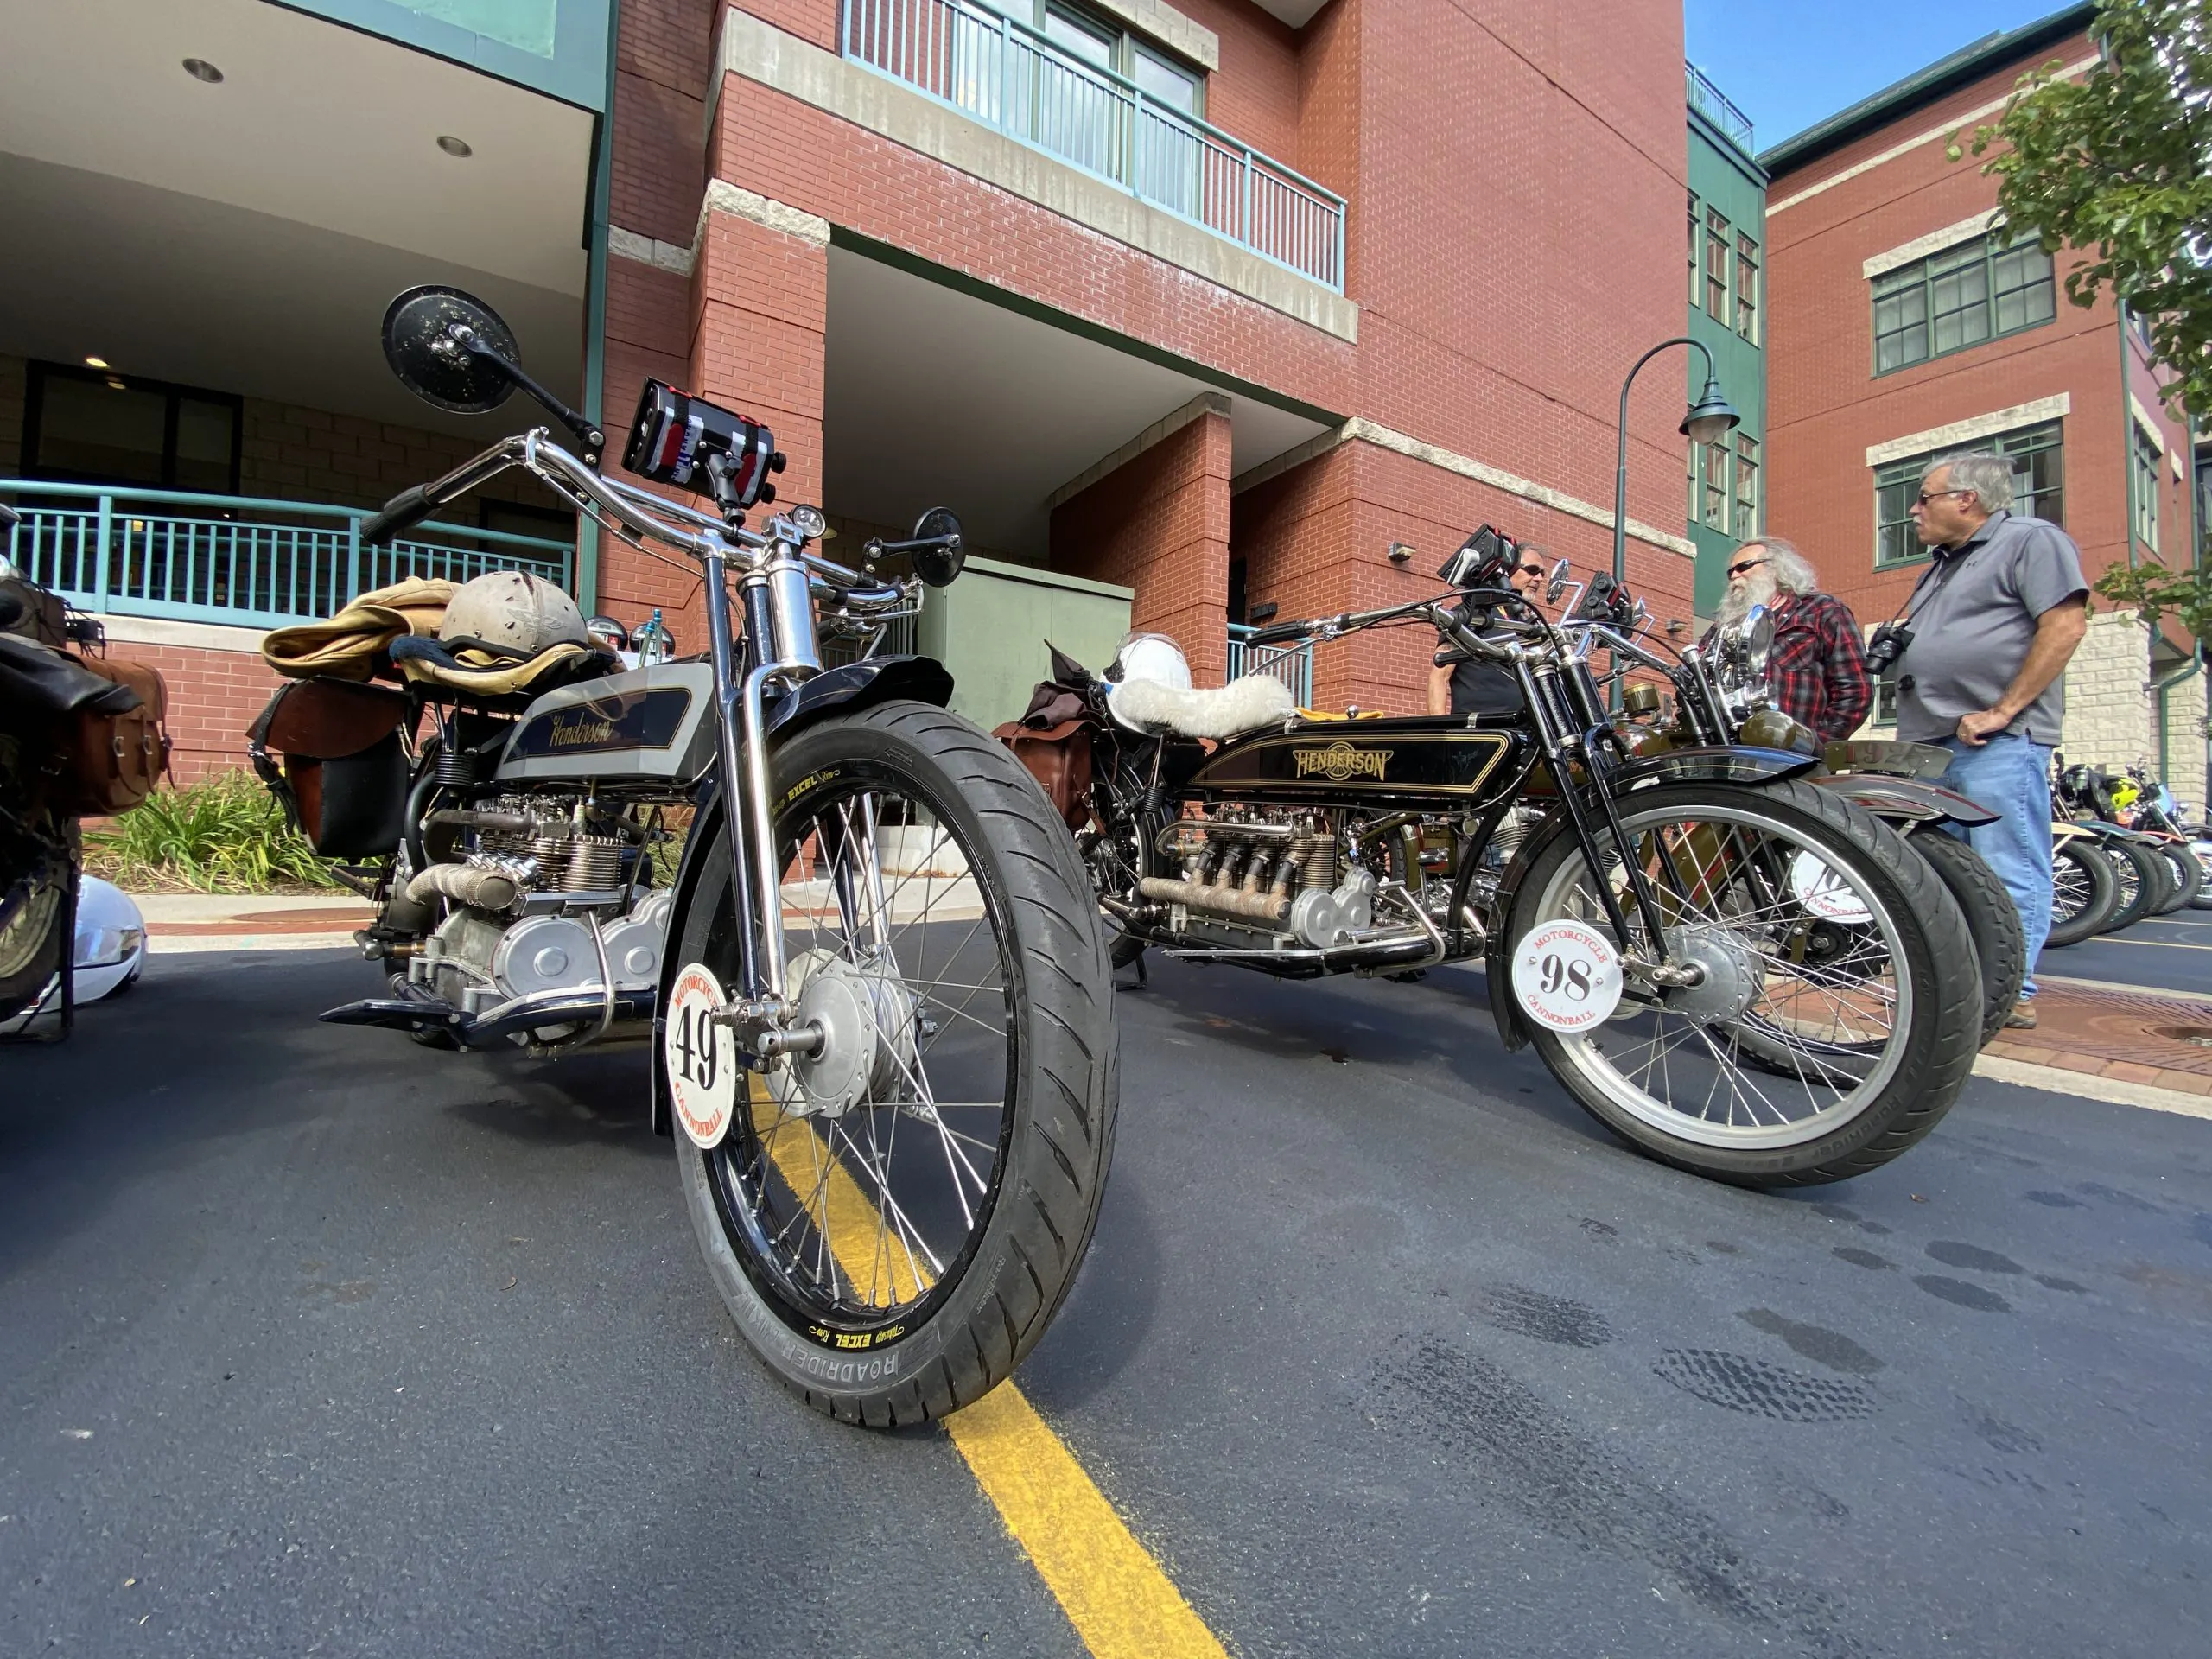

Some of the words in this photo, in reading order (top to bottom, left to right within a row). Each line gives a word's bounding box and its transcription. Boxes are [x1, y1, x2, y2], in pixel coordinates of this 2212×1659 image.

[549, 712, 614, 747] Henderson
[1294, 749, 1388, 781] HENDERSON
[787, 776, 817, 801] EXCEL
[1534, 930, 1608, 963] MOTORCYCLE
[675, 975, 718, 1011] MOTORCYCL
[1540, 954, 1592, 1001] 98
[1527, 995, 1596, 1026] CANNONBALL
[676, 1004, 717, 1091] 49
[675, 1081, 723, 1136] CANNONBALL
[836, 1333, 872, 1349] EXCEL
[781, 1344, 899, 1382] ROADRIDER
